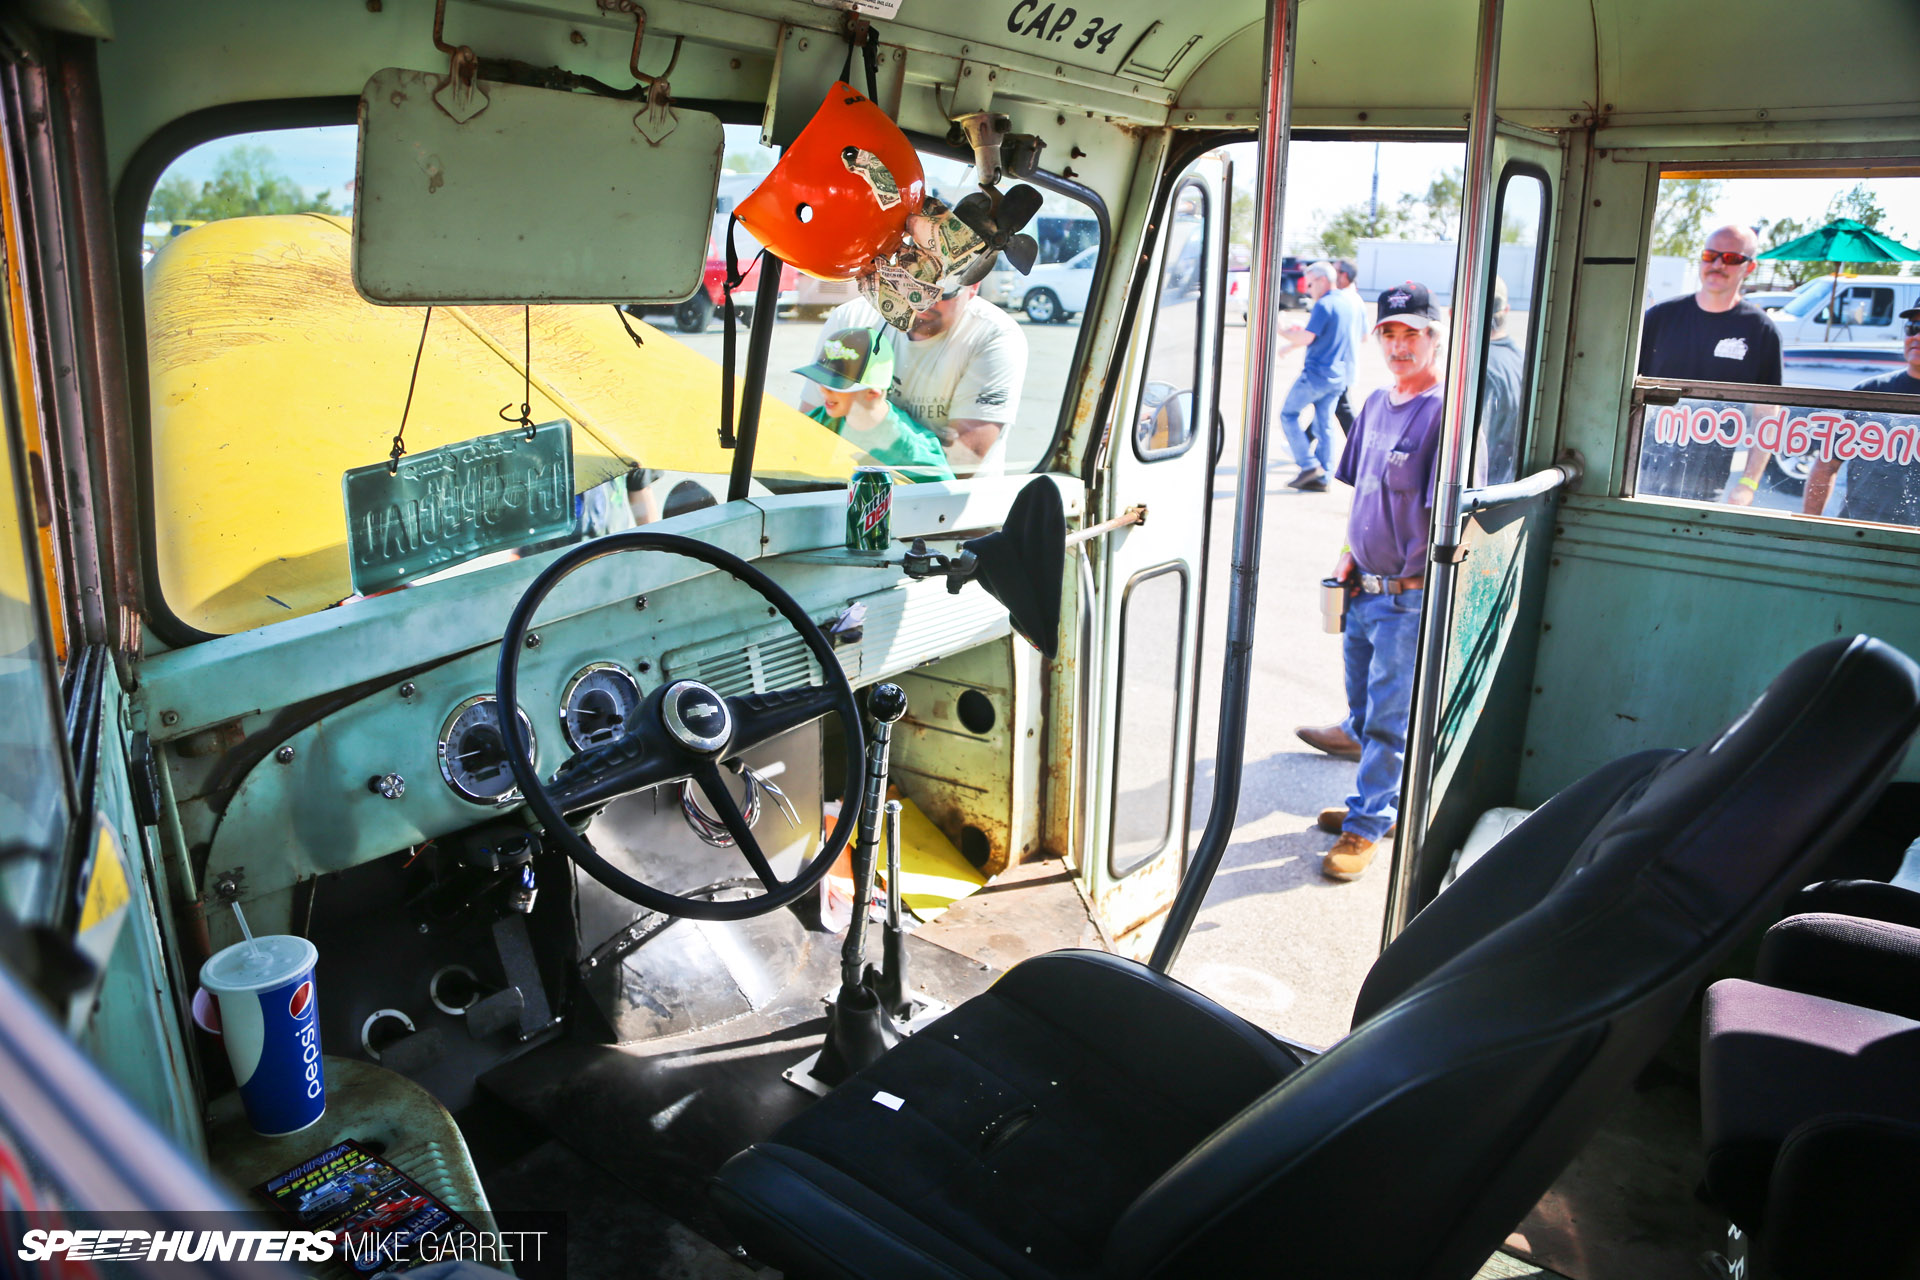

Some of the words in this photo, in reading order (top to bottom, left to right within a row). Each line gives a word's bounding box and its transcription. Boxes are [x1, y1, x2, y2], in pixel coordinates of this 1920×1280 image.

[1007, 0, 1077, 42] CAP.
[1073, 17, 1123, 54] 34
[295, 1021, 322, 1099] pepsi
[276, 1150, 360, 1198] SPRING
[304, 1154, 369, 1191] DIESEL
